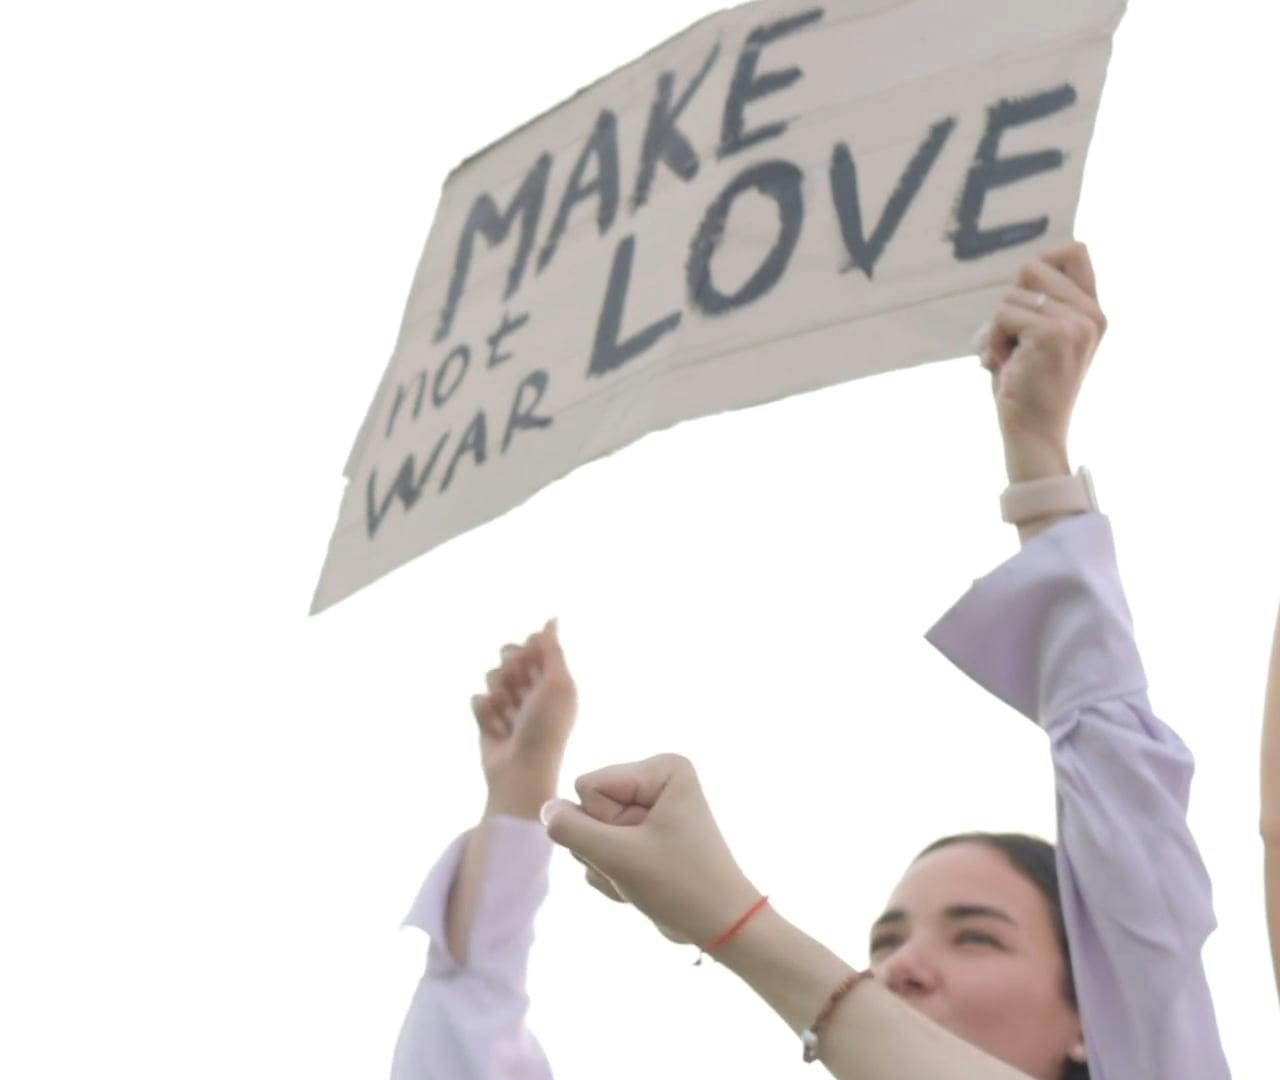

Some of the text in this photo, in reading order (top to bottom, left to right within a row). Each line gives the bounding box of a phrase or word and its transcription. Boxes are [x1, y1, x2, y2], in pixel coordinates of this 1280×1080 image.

[433, 8, 825, 343] MAKE
[586, 83, 1077, 379] LOVE
[365, 370, 553, 541] WAR
[384, 312, 530, 438] not
